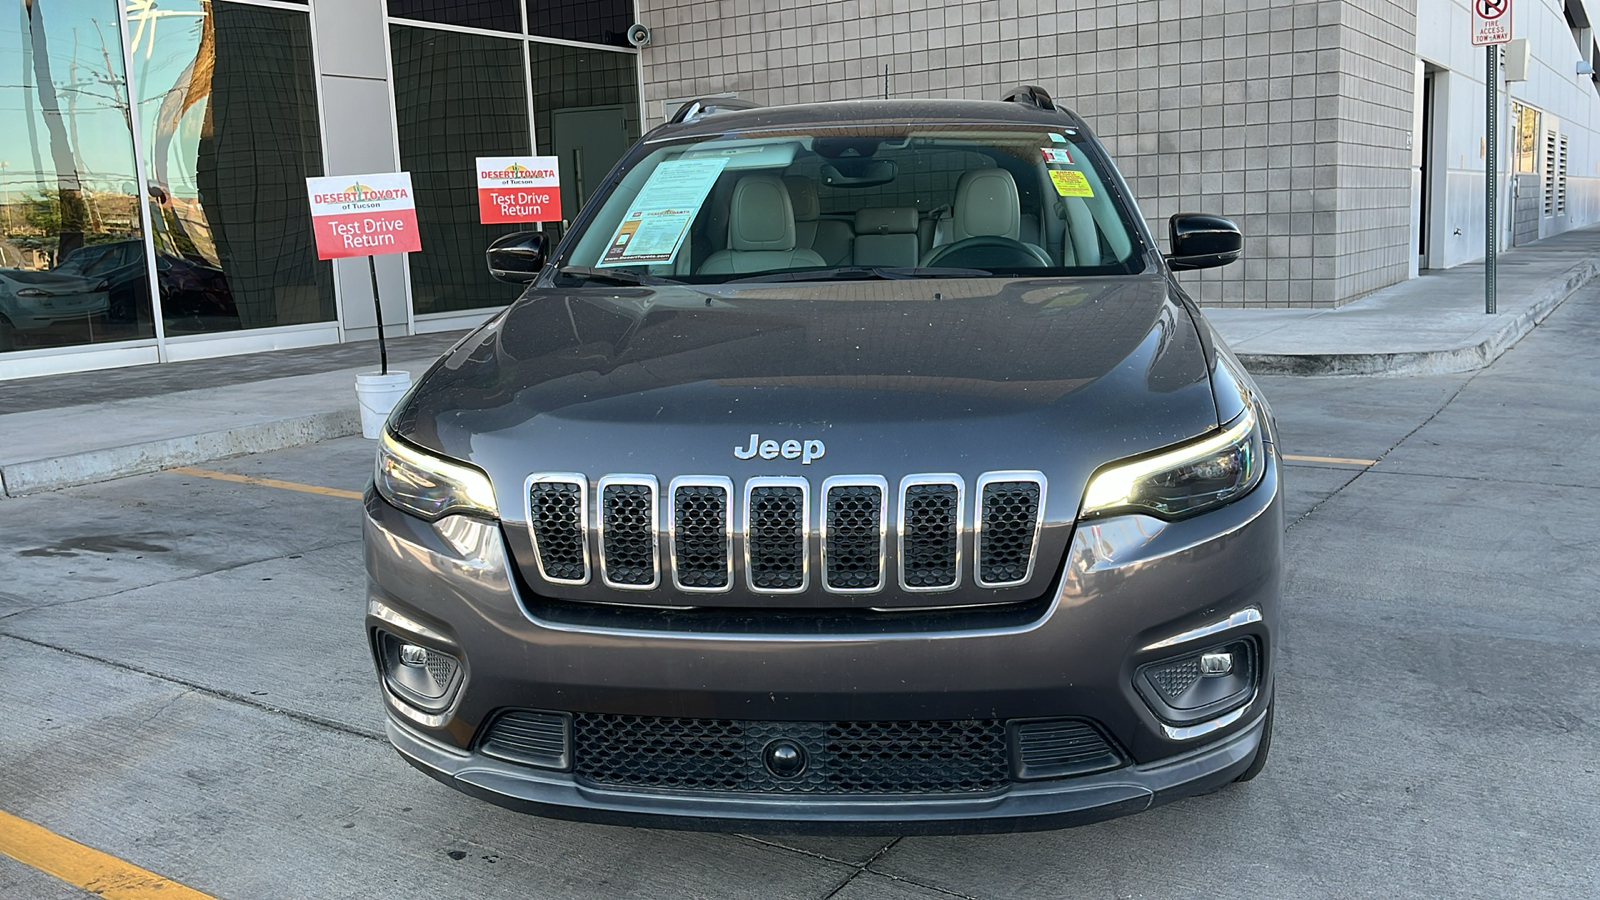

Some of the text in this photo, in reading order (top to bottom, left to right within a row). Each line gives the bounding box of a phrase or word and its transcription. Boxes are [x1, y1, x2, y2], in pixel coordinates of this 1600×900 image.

[1480, 26, 1505, 34] ACCESS
[1476, 33, 1508, 42] TOW-AWAY
[520, 170, 555, 178] TOYOTA
[314, 188, 408, 204] DESERT TOYOTA
[490, 192, 550, 205] Test Drive
[501, 204, 541, 216] Return
[328, 218, 404, 236] Test Drive
[343, 234, 394, 248] Return
[734, 434, 826, 464] Jeep
